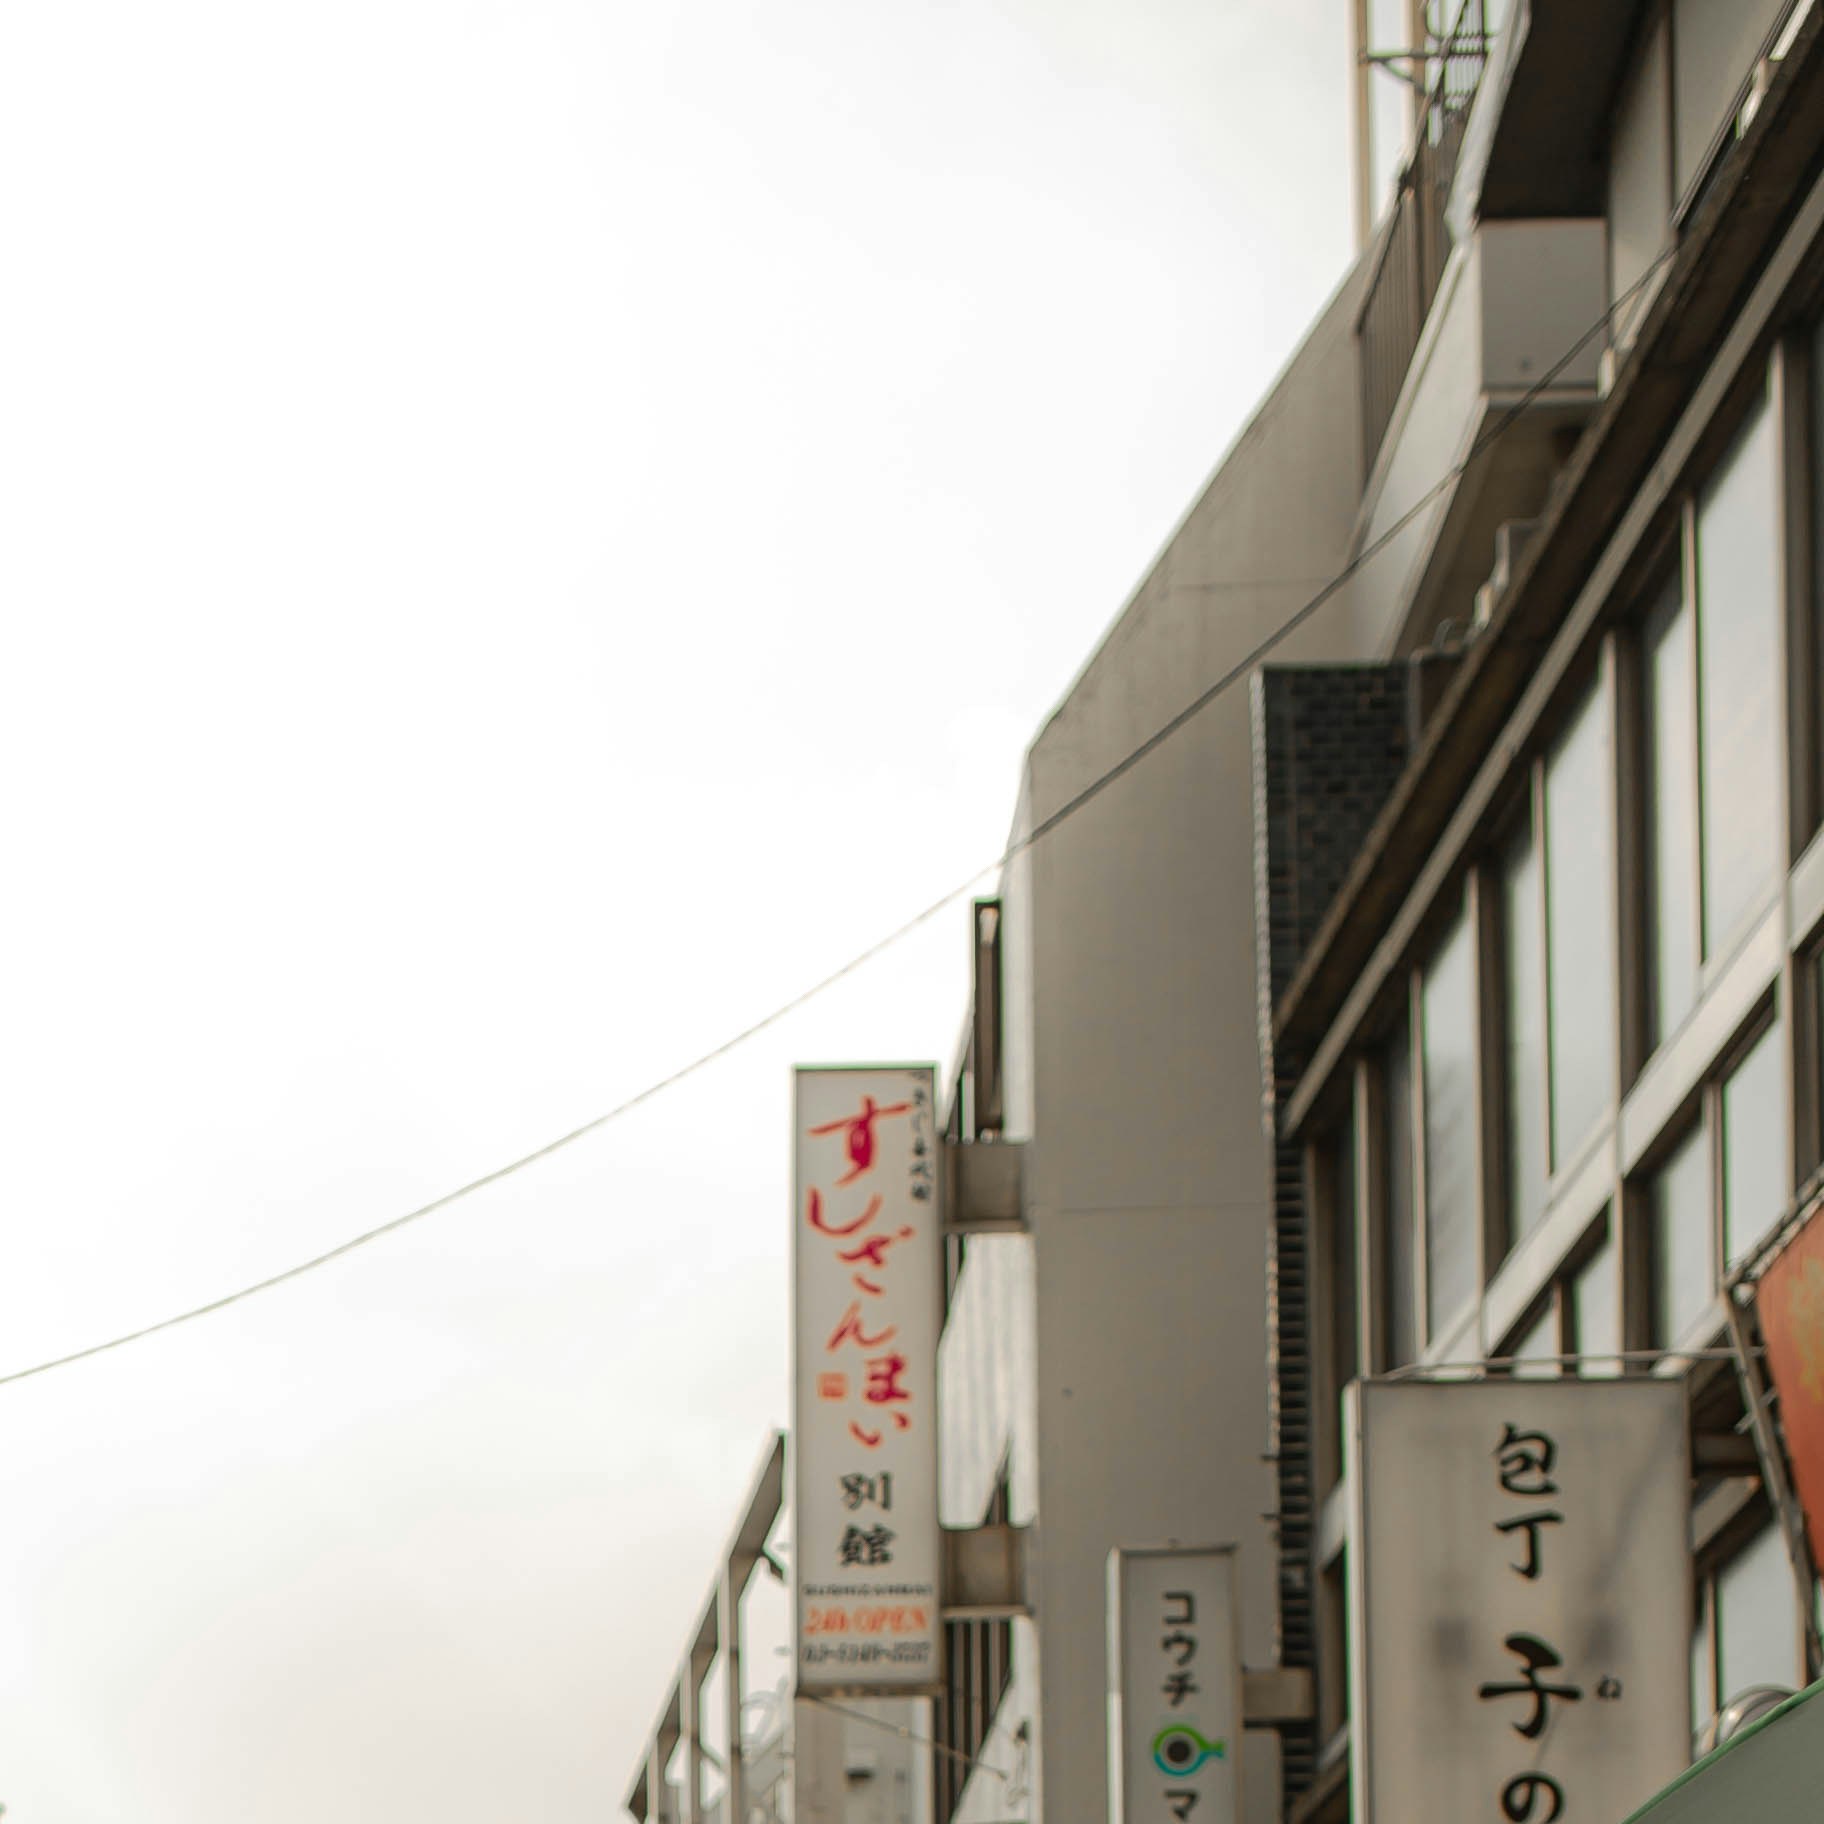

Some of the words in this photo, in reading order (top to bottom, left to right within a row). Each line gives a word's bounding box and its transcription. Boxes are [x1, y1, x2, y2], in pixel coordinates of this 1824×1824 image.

[807, 1096, 914, 1447] すしざんまい
[839, 1471, 896, 1568] 別館
[1497, 1423, 1562, 1581] 包丁
[1164, 1591, 1200, 1707] コウチ
